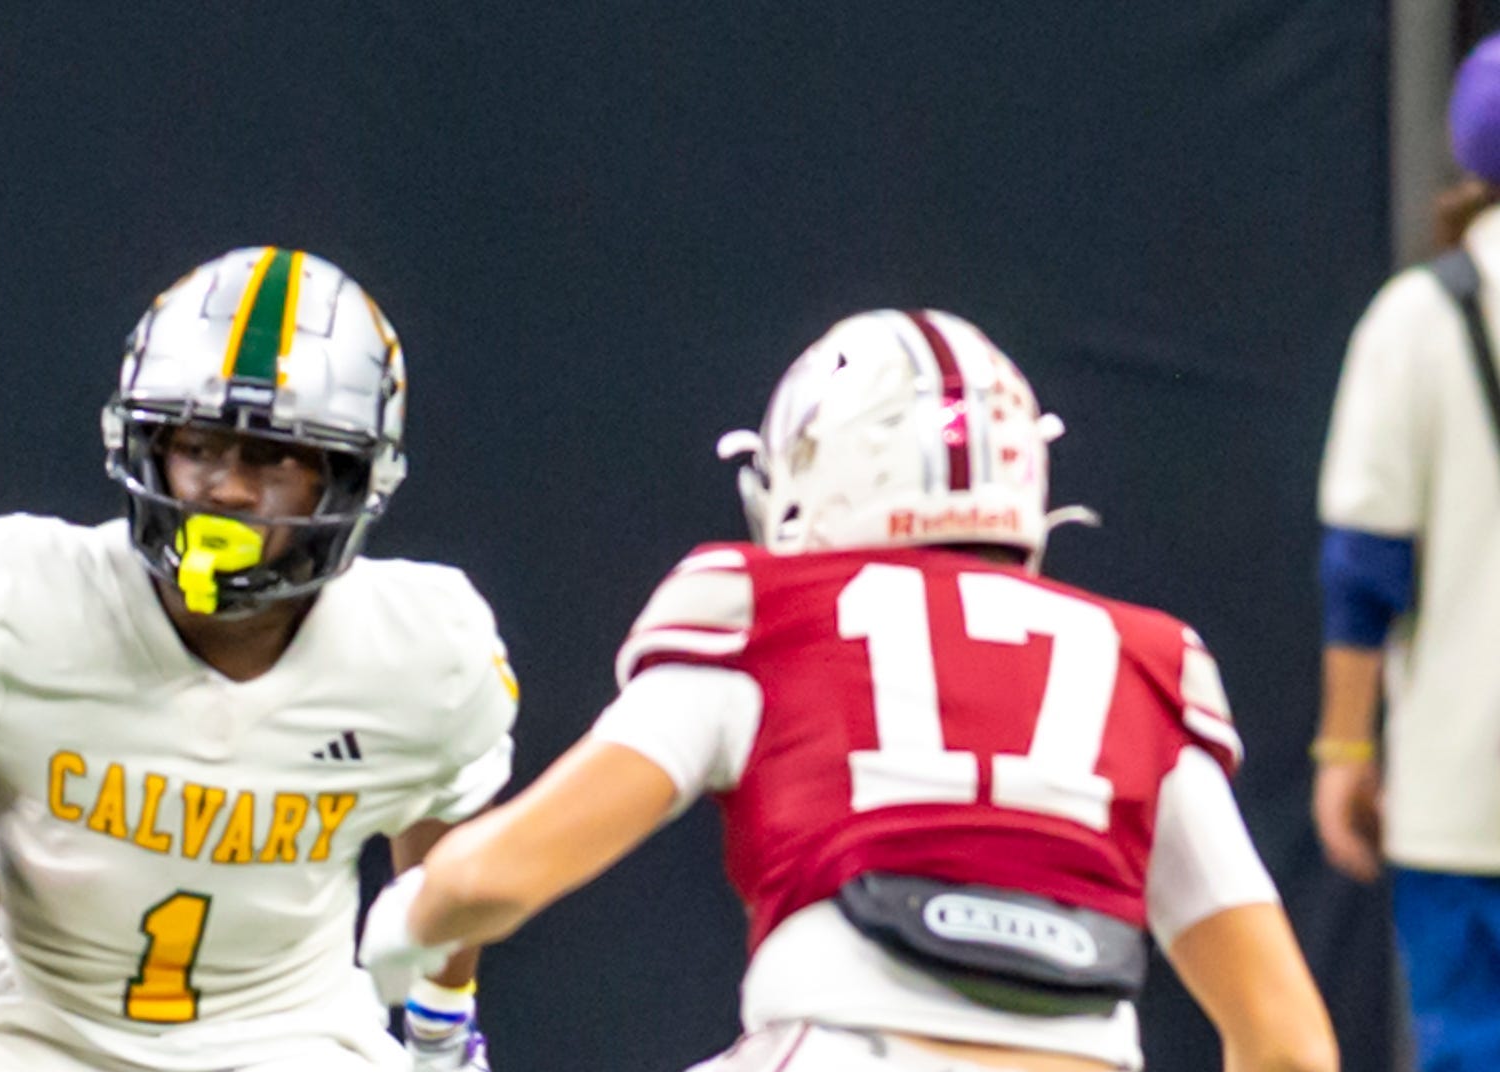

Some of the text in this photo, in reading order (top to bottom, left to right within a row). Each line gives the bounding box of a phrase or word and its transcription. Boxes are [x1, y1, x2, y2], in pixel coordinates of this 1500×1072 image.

[837, 563, 1121, 832] 17
[48, 751, 357, 865] CALVARY
[124, 889, 213, 1023] 1
